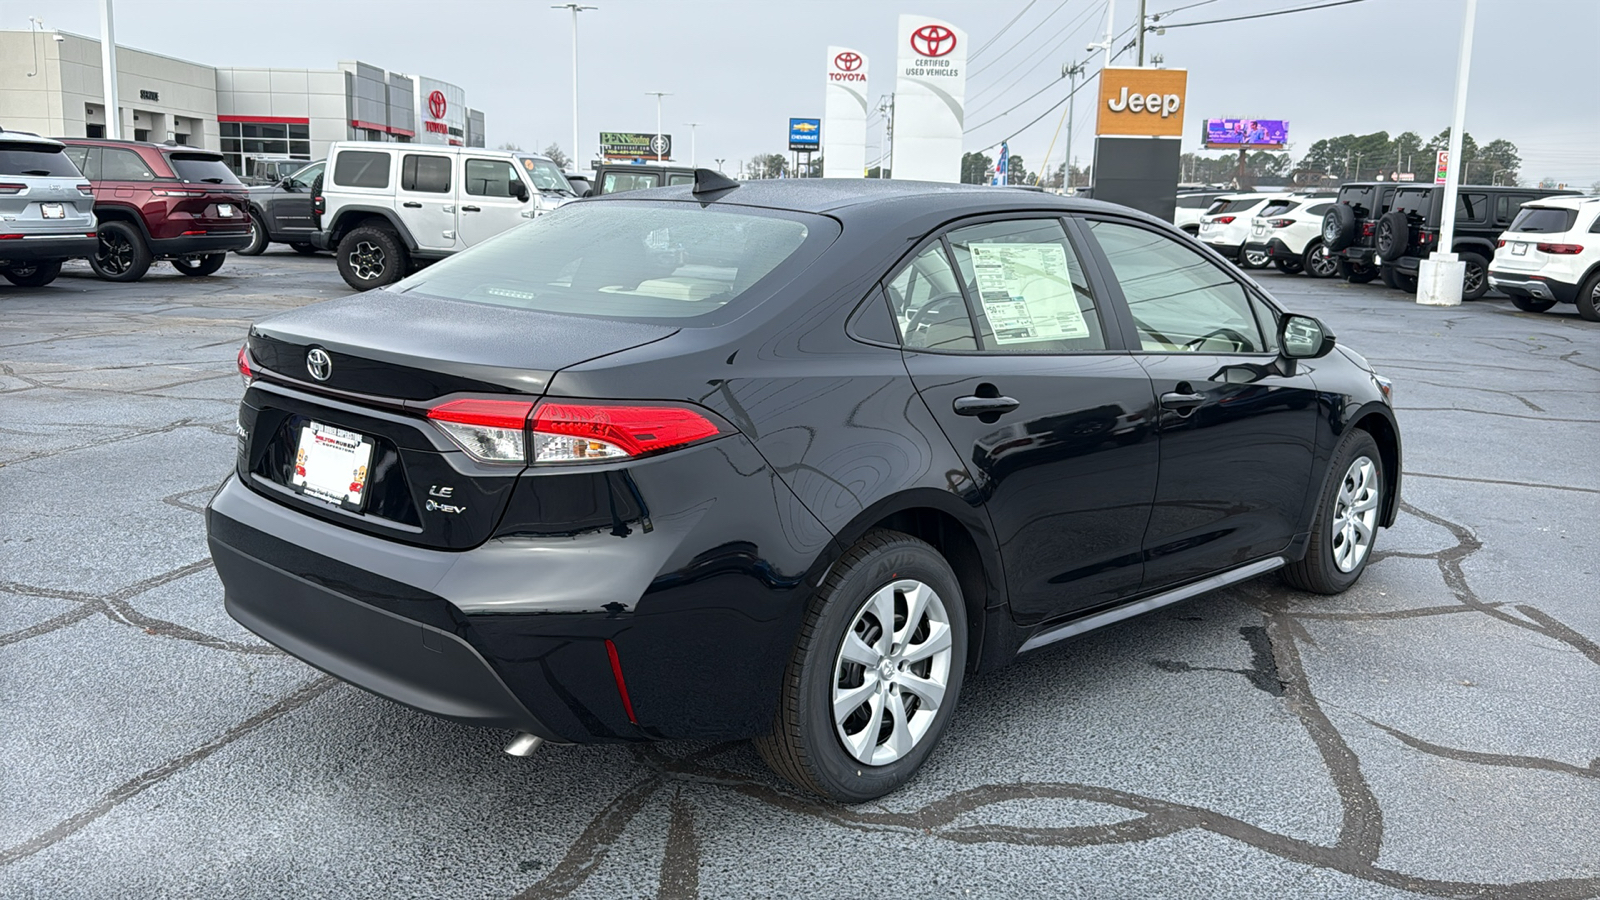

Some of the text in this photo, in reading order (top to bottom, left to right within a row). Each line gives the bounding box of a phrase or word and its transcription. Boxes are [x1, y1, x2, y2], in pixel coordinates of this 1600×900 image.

[915, 59, 950, 67] CERTIFIED
[829, 73, 867, 82] TOYOTA
[905, 68, 959, 77] USED VEHICLES
[1107, 87, 1180, 118] Jeep
[425, 121, 448, 134] TOYOTA
[315, 434, 356, 450] MILTON RUBEN
[429, 485, 454, 498] LE
[434, 501, 467, 514] HEV
[876, 555, 915, 578] AVID
